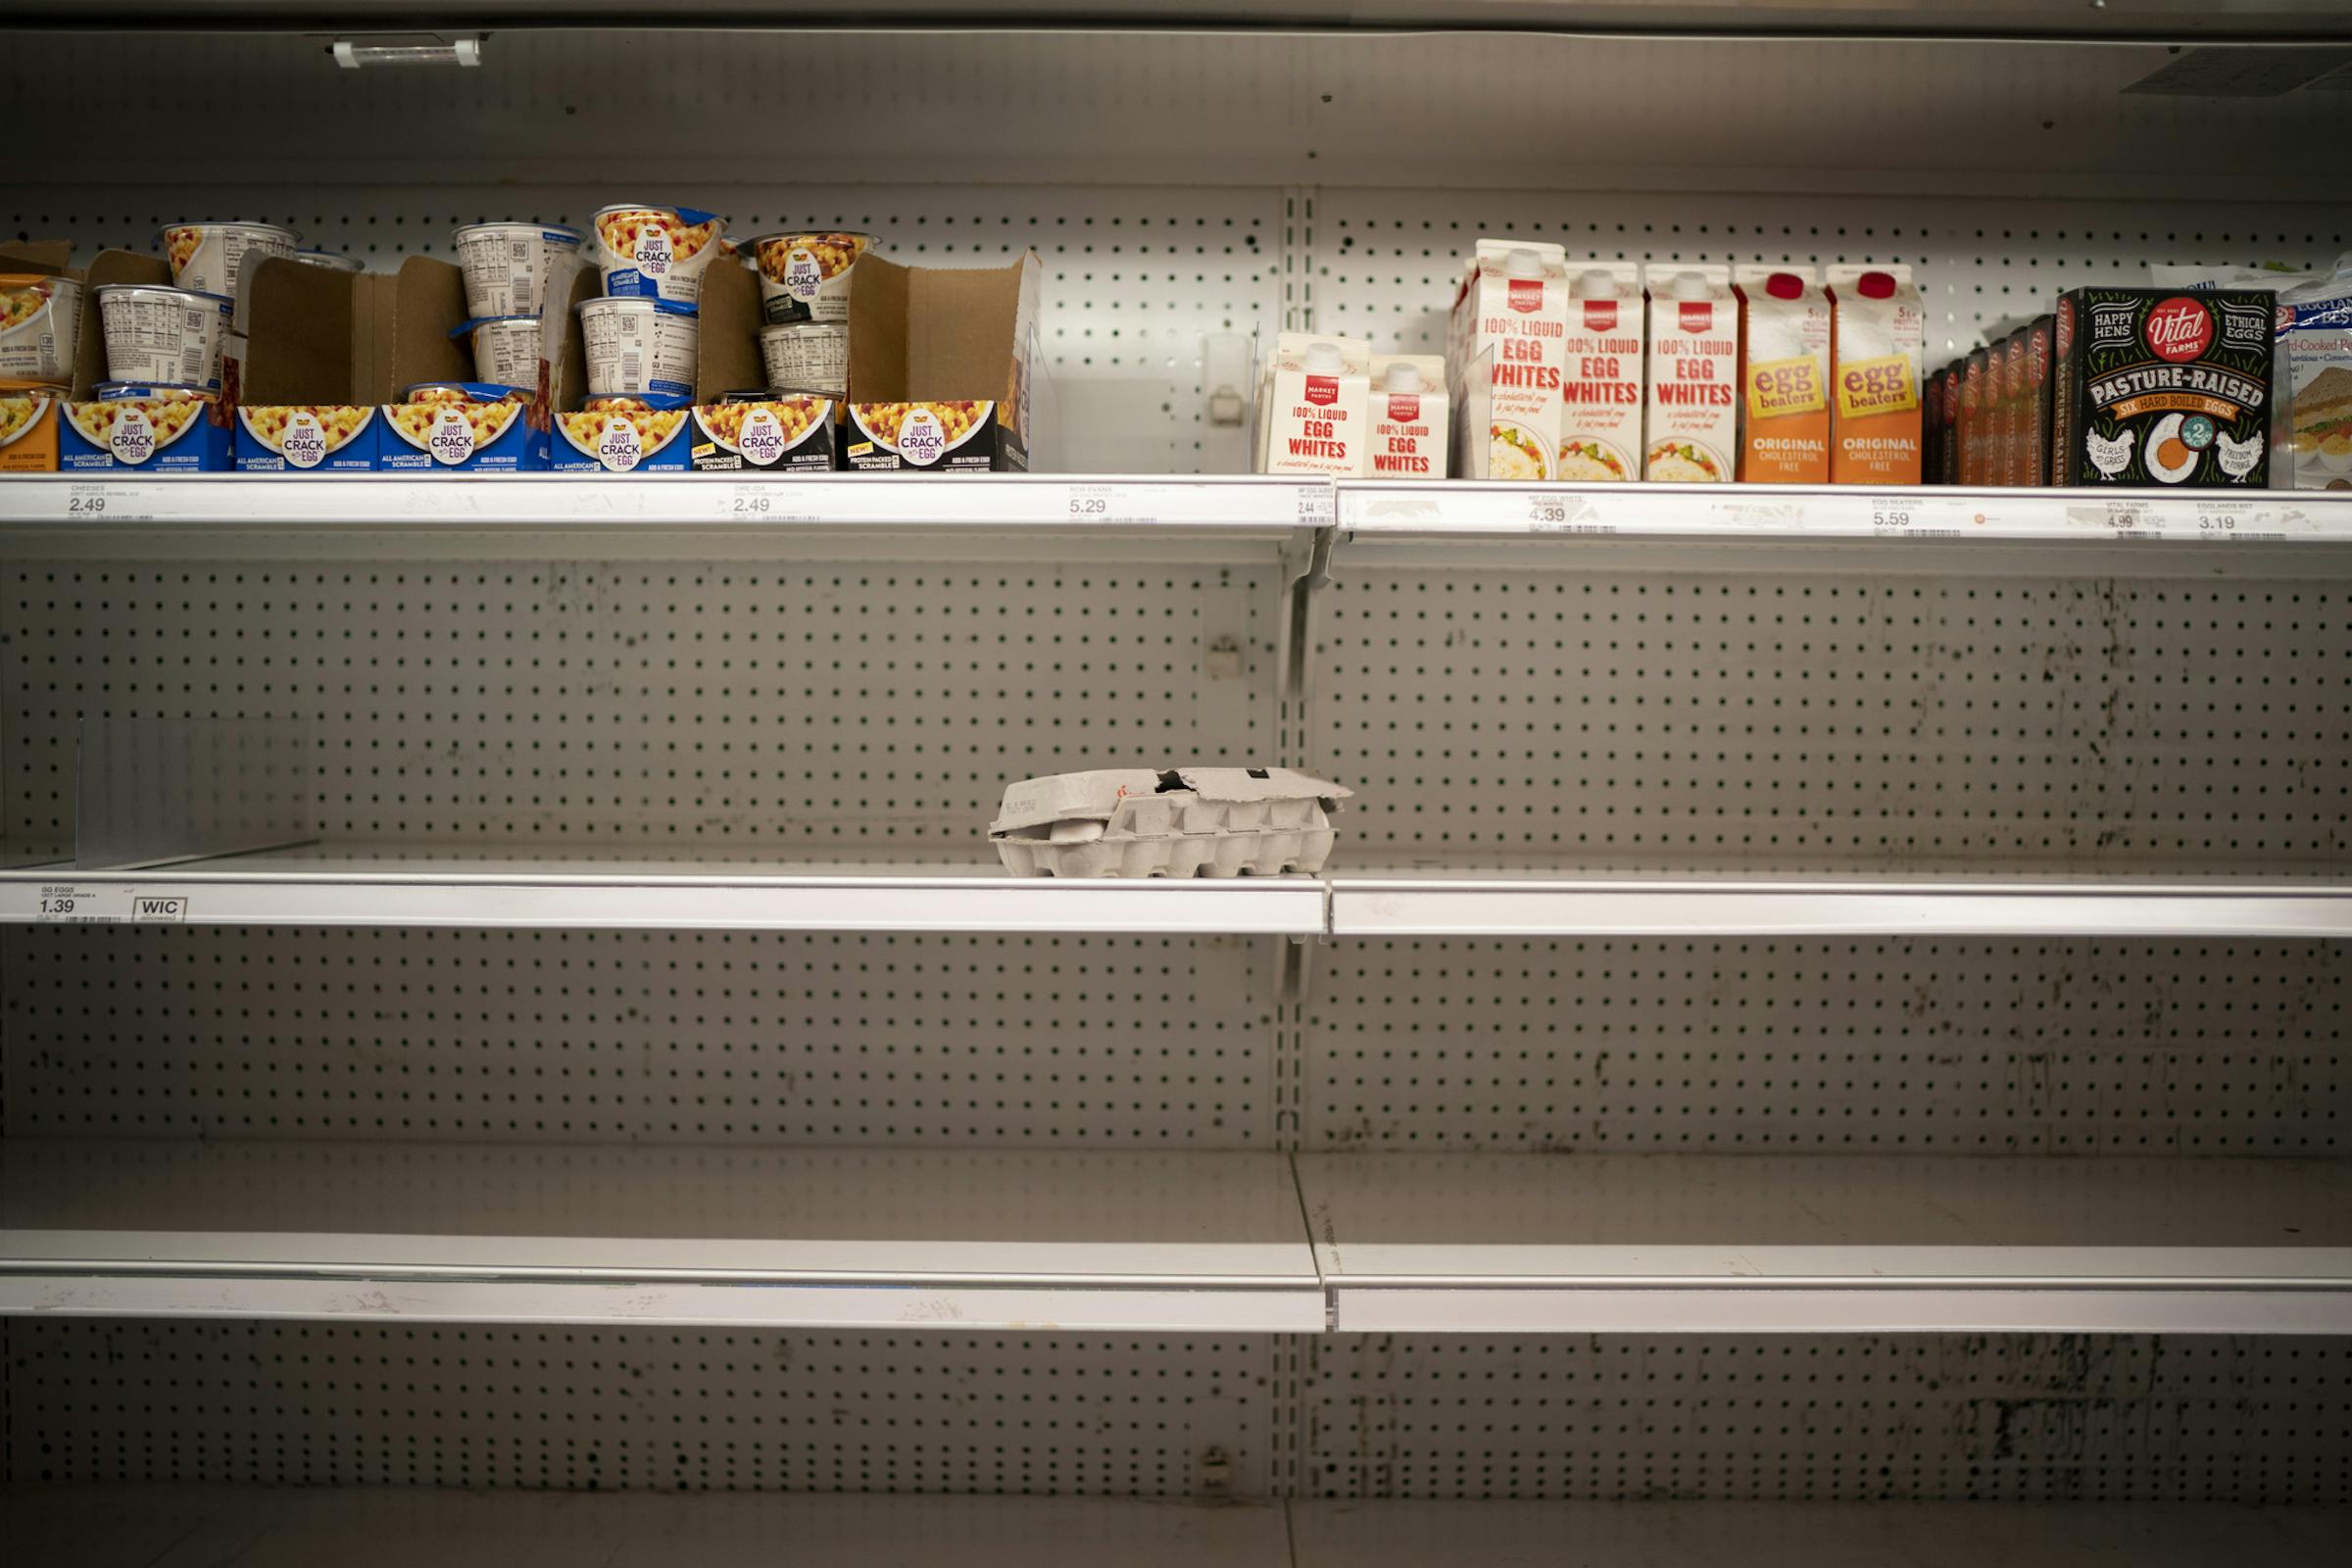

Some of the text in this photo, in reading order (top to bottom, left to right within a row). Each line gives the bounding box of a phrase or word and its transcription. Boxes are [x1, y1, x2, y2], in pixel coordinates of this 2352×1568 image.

[644, 240, 663, 251] JUST
[636, 251, 671, 263] CRACK
[651, 262, 665, 273] EGG
[793, 264, 811, 274] JUST
[787, 274, 820, 286] CRACK
[801, 285, 815, 296] EGG
[1510, 290, 1541, 301] MARKET
[2094, 312, 2134, 326] HAPPY
[2225, 315, 2267, 330] ETHICAL
[2322, 310, 2352, 324] BES
[1485, 318, 1563, 338] 100% LIQUID
[2057, 299, 2070, 351] Vital
[2148, 307, 2204, 345] Vital
[2094, 325, 2131, 339] HENS
[2226, 328, 2264, 341] EGGS
[1502, 338, 1543, 363] EGG
[1568, 338, 1639, 354] 00% LIQUID
[1657, 339, 1733, 356] 100% LIQUID
[2166, 341, 2199, 355] FARMS
[2289, 338, 2352, 352] rd-Cooked Pe
[1581, 358, 1619, 378] EGG
[1676, 359, 1714, 380] EGG
[1755, 363, 1812, 395] egg
[1844, 362, 1903, 395] egg
[1308, 385, 1336, 395] MARKET
[1563, 382, 1638, 405] WHITES
[1657, 383, 1733, 406] WHITES
[1760, 393, 1815, 409] beaters
[1849, 391, 1906, 409] beaters
[2119, 395, 2233, 416] SIX HARD BOILED EGGS
[1293, 407, 1348, 421] 100% LIQUID
[122, 424, 143, 435] JUST
[293, 428, 314, 439] JUST
[441, 425, 463, 435] JUST
[751, 425, 772, 436] JUST
[910, 425, 932, 437] JUST
[1303, 420, 1333, 438] EGG
[1376, 423, 1429, 436] 100% LIQUID
[2192, 422, 2205, 439] 2
[113, 435, 153, 448] CRACK
[284, 440, 323, 450] CRACK
[431, 437, 471, 447] CRACK
[610, 433, 630, 444] JUST
[742, 436, 783, 448] CRACK
[902, 437, 943, 448] CRACK
[1388, 437, 1416, 453] EGG
[1753, 438, 1825, 452] ORIGINAL
[1842, 438, 1917, 451] ORIGINAL
[130, 447, 146, 458] EGG
[449, 447, 465, 458] EGG
[601, 444, 639, 455] CRACK
[760, 448, 776, 458] EGG
[850, 445, 869, 455] NEW!
[919, 448, 935, 459] EGG
[1289, 438, 1347, 459] WHITES
[2096, 444, 2125, 456] GIRLS
[302, 451, 318, 462] EGG
[617, 456, 633, 466] EGG
[1759, 451, 1818, 463] CHOLESTEROL
[1849, 450, 1910, 462] CHOLESTEROL
[2104, 455, 2126, 466] GRASS
[1374, 455, 1429, 472] WHITES
[1779, 462, 1799, 471] FREE
[1870, 461, 1890, 471] FREE
[69, 498, 105, 512] 2.49
[733, 498, 770, 512] 2.49
[1069, 499, 1105, 513] 5.29
[1298, 502, 1314, 514] 2.44
[1529, 508, 1565, 521] 4.39
[1874, 512, 1909, 525] 5.59
[2108, 514, 2133, 528] 4.99
[2198, 515, 2234, 529] 3.19
[40, 900, 74, 912] 1.39
[142, 901, 178, 913] WIC
